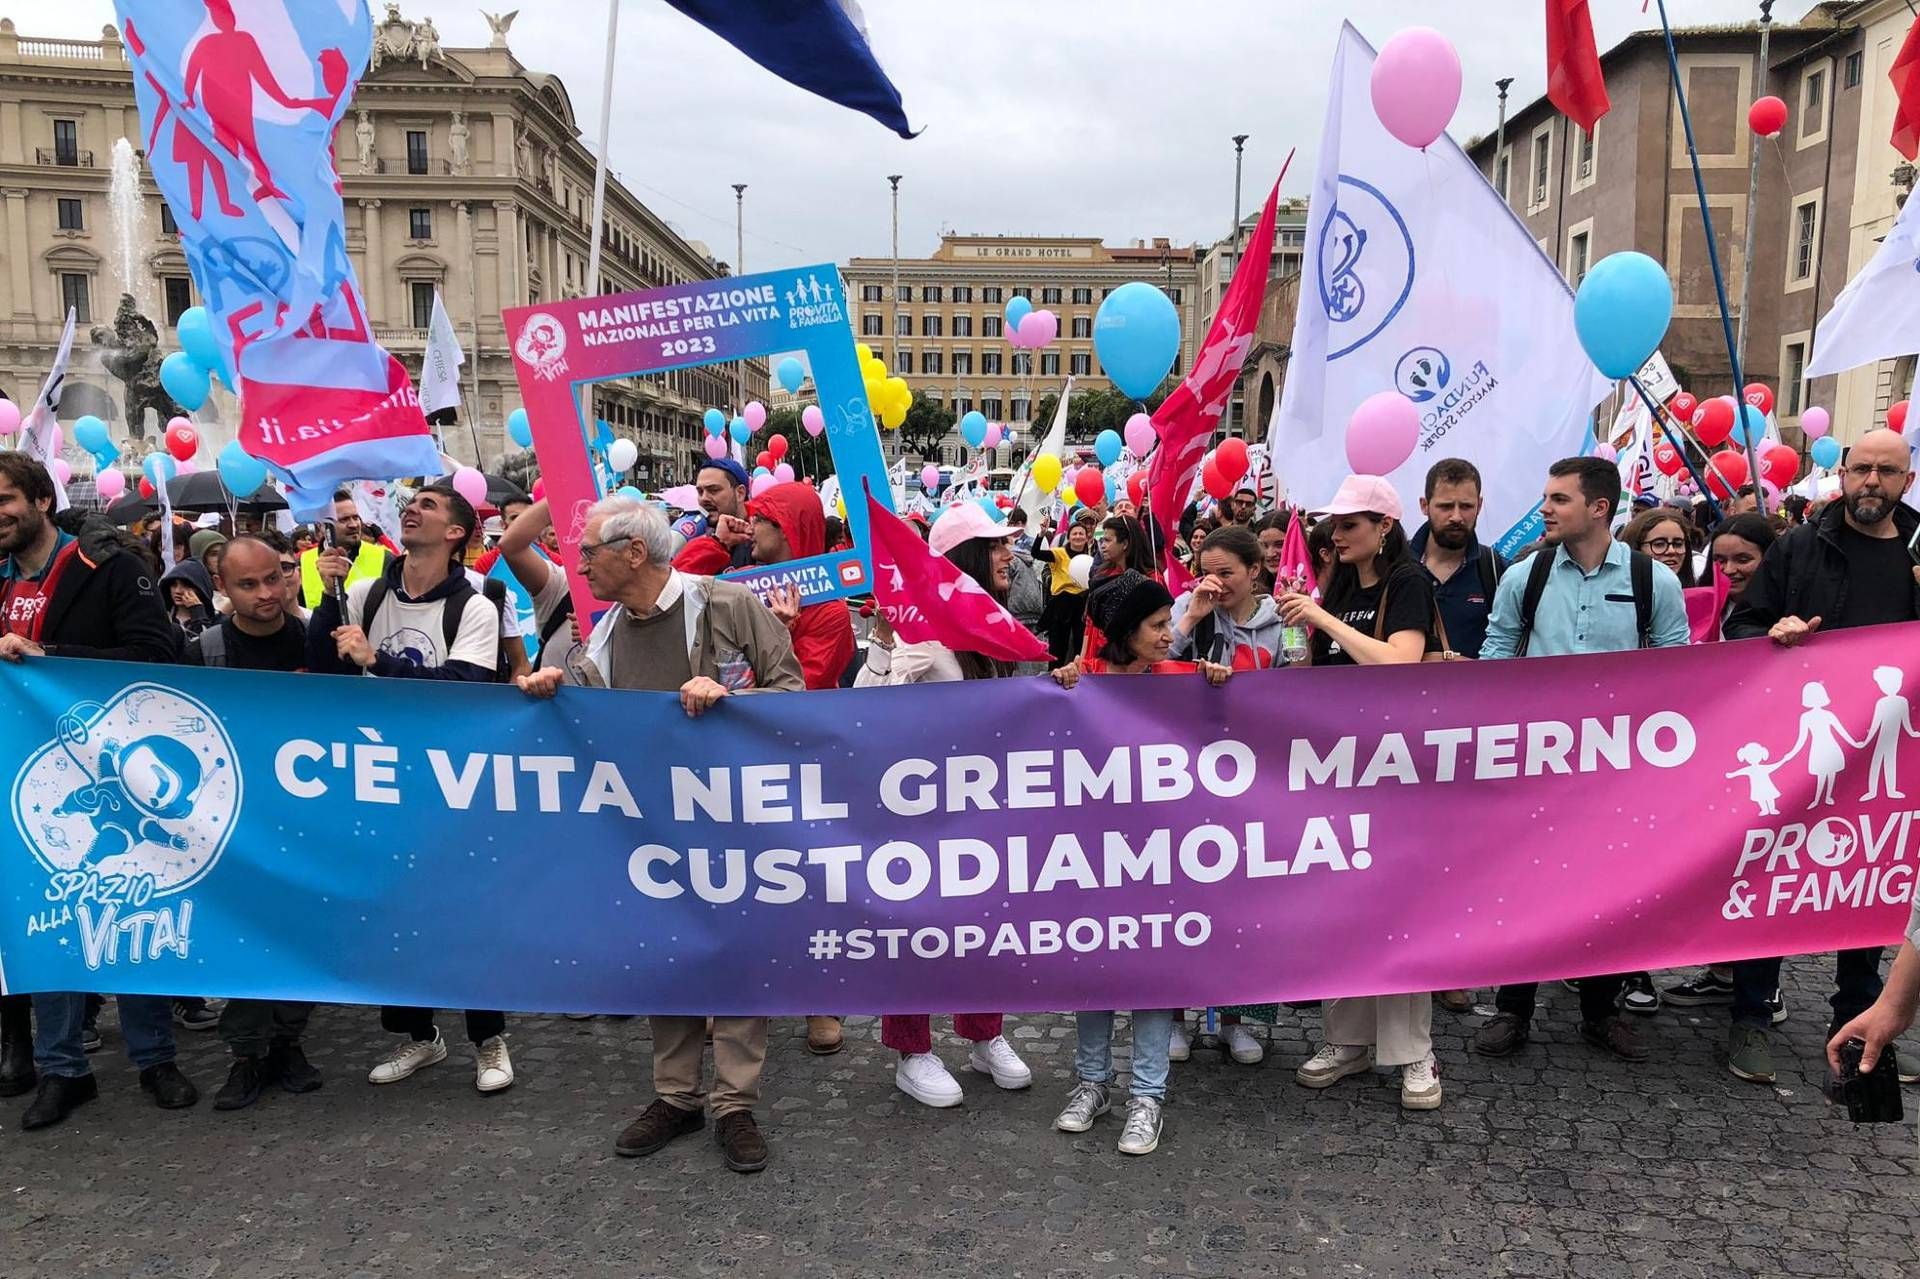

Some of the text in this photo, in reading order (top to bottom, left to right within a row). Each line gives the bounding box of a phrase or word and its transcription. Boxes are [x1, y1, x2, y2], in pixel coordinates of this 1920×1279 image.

[977, 248, 1073, 258] LE GRAND HOTEL
[577, 285, 777, 330] MANIFESTAZIONE
[583, 305, 781, 347] NAZIONALE PER LA VITA
[798, 312, 844, 328] FAMIGLIA
[660, 335, 717, 357] 2023
[745, 566, 829, 592] MOLAVITA
[274, 711, 1697, 824] C'È VITA NEL GREMBO MATERNO
[627, 813, 1373, 905] CUSTODIAMOLA!
[1733, 810, 1920, 877] PROVI
[44, 871, 156, 907] SPAZIO
[1721, 864, 1920, 920] & FAMIG
[27, 899, 193, 971] ALLA VITA!
[807, 911, 1213, 961] #STOPABORTO
